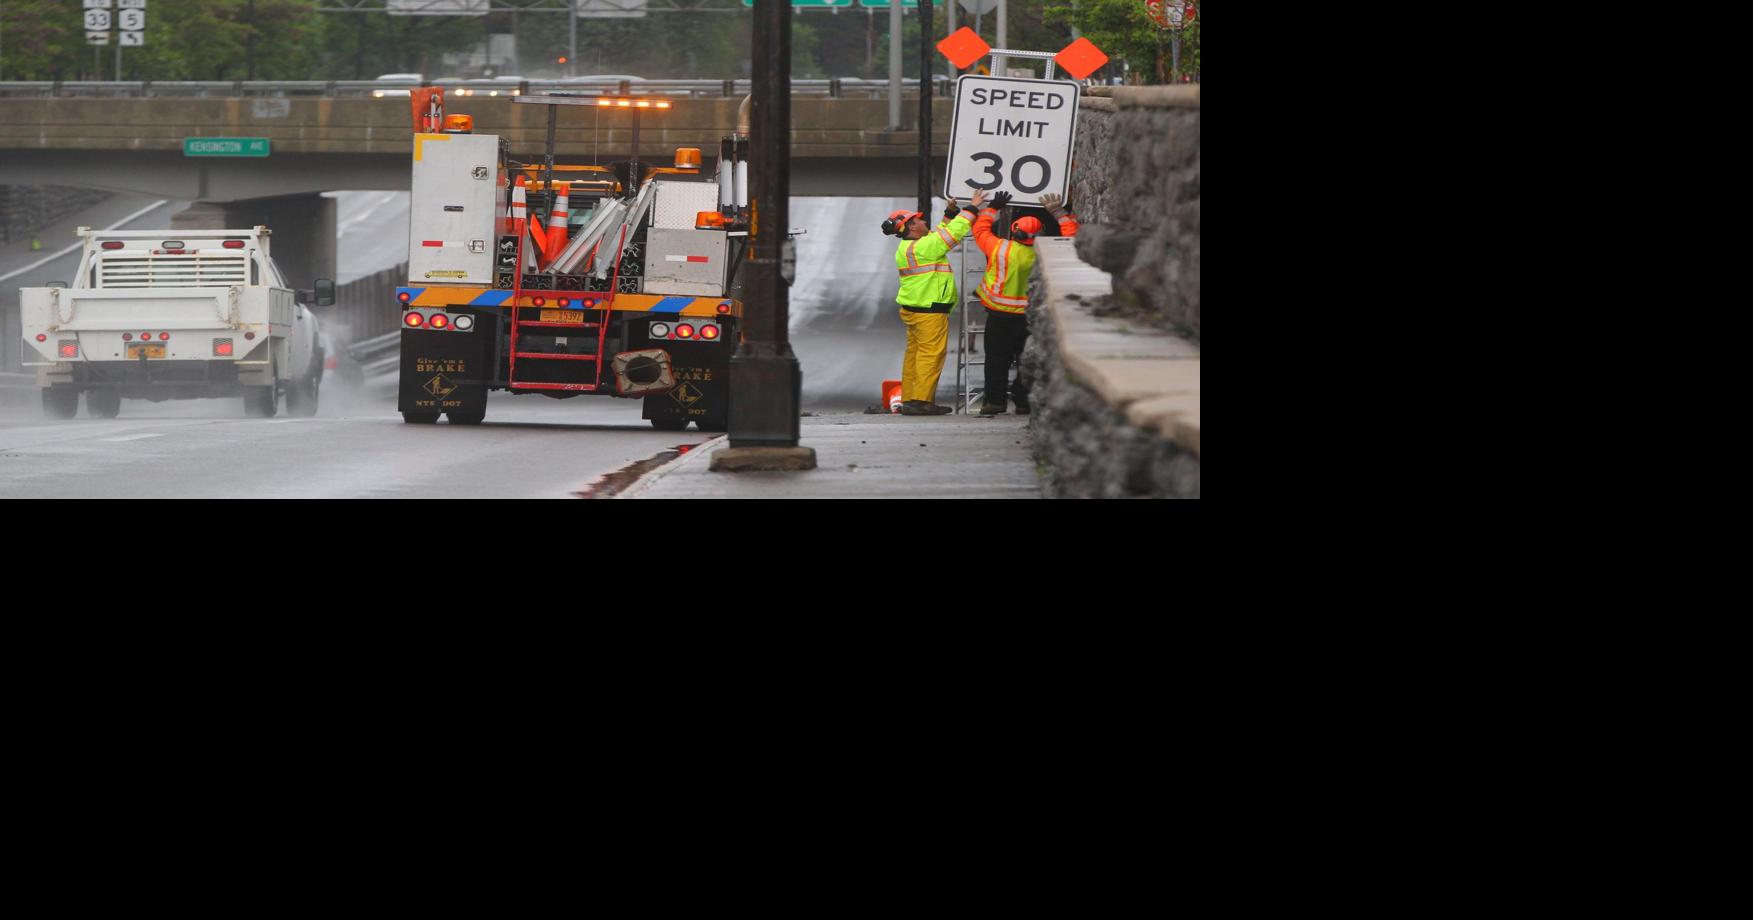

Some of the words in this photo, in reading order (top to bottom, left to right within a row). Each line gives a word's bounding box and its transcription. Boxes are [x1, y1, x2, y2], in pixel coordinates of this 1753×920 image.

[87, 13, 107, 26] 33
[127, 13, 138, 27] 5
[970, 87, 1065, 110] SPEED
[978, 117, 1049, 139] LIMIT
[189, 141, 242, 152] KENSINGTON
[964, 151, 1052, 194] 30
[416, 364, 465, 372] BRAKE
[673, 372, 712, 380] RAKE
